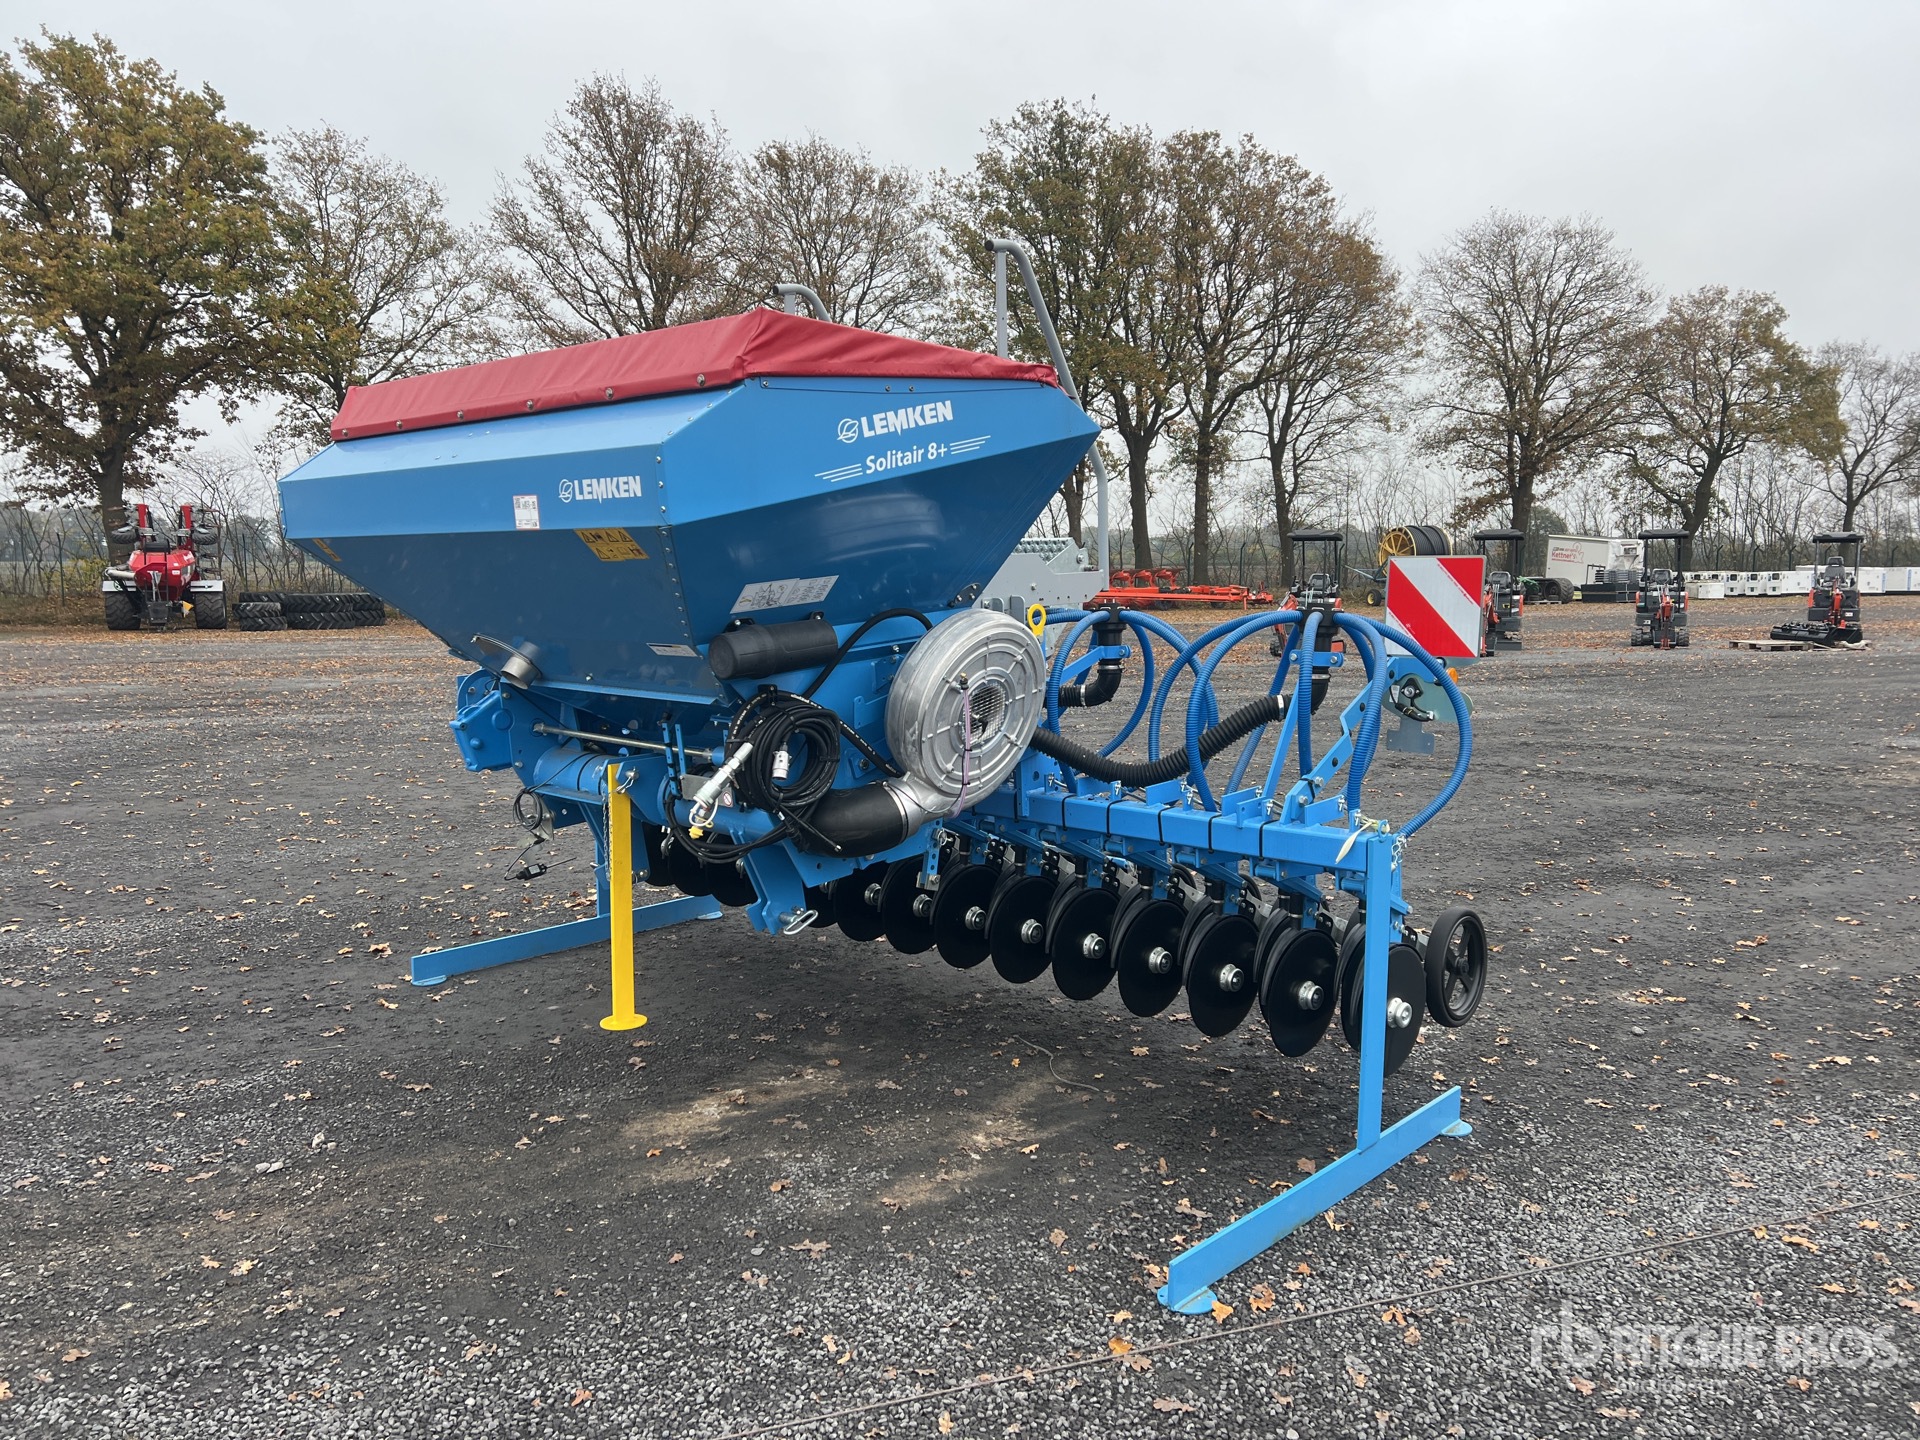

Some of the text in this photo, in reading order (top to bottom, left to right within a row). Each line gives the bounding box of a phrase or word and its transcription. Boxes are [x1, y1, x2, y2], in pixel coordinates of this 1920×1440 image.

[861, 400, 953, 437] LEMKEN
[866, 442, 947, 474] Solitair 8+
[574, 475, 642, 504] LEMKEN
